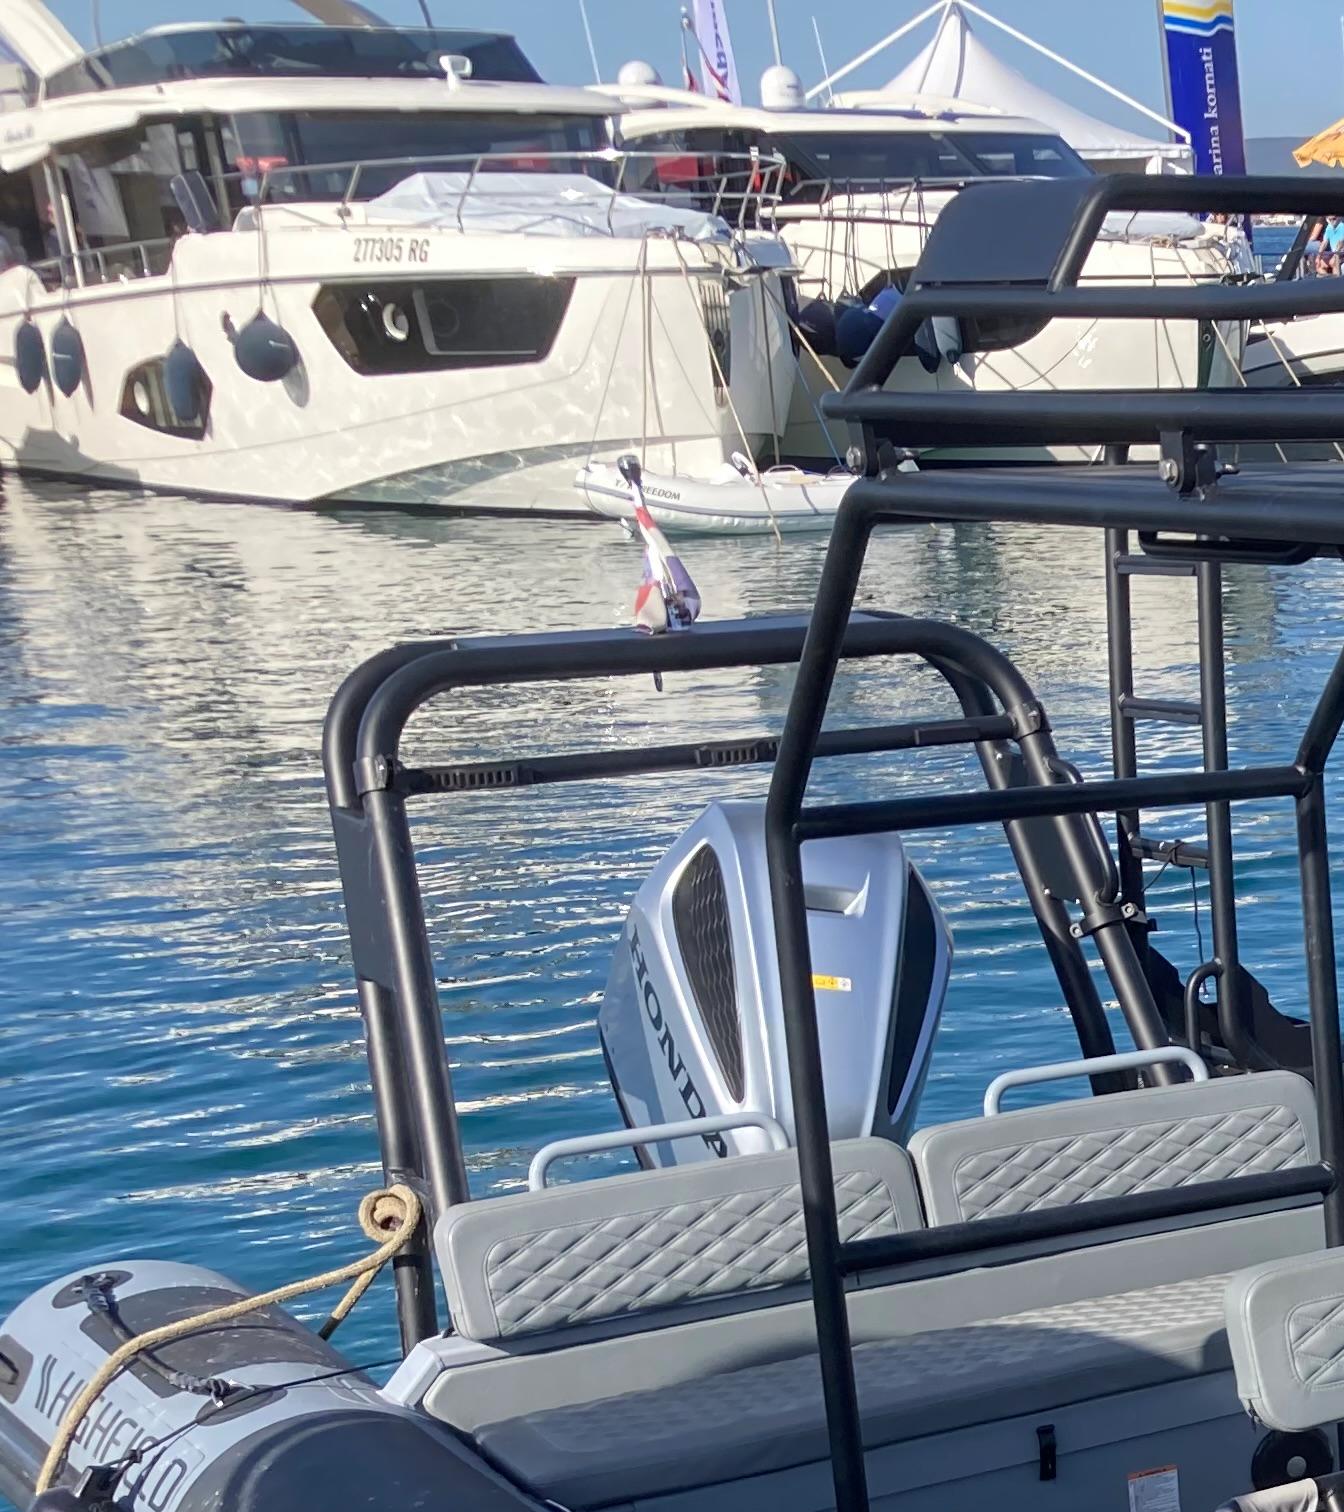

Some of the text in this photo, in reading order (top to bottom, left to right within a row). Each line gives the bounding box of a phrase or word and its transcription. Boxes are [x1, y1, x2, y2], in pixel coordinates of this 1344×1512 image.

[1199, 47, 1223, 176] arina kornati
[408, 238, 431, 262] RG
[641, 485, 681, 501] REEDOM
